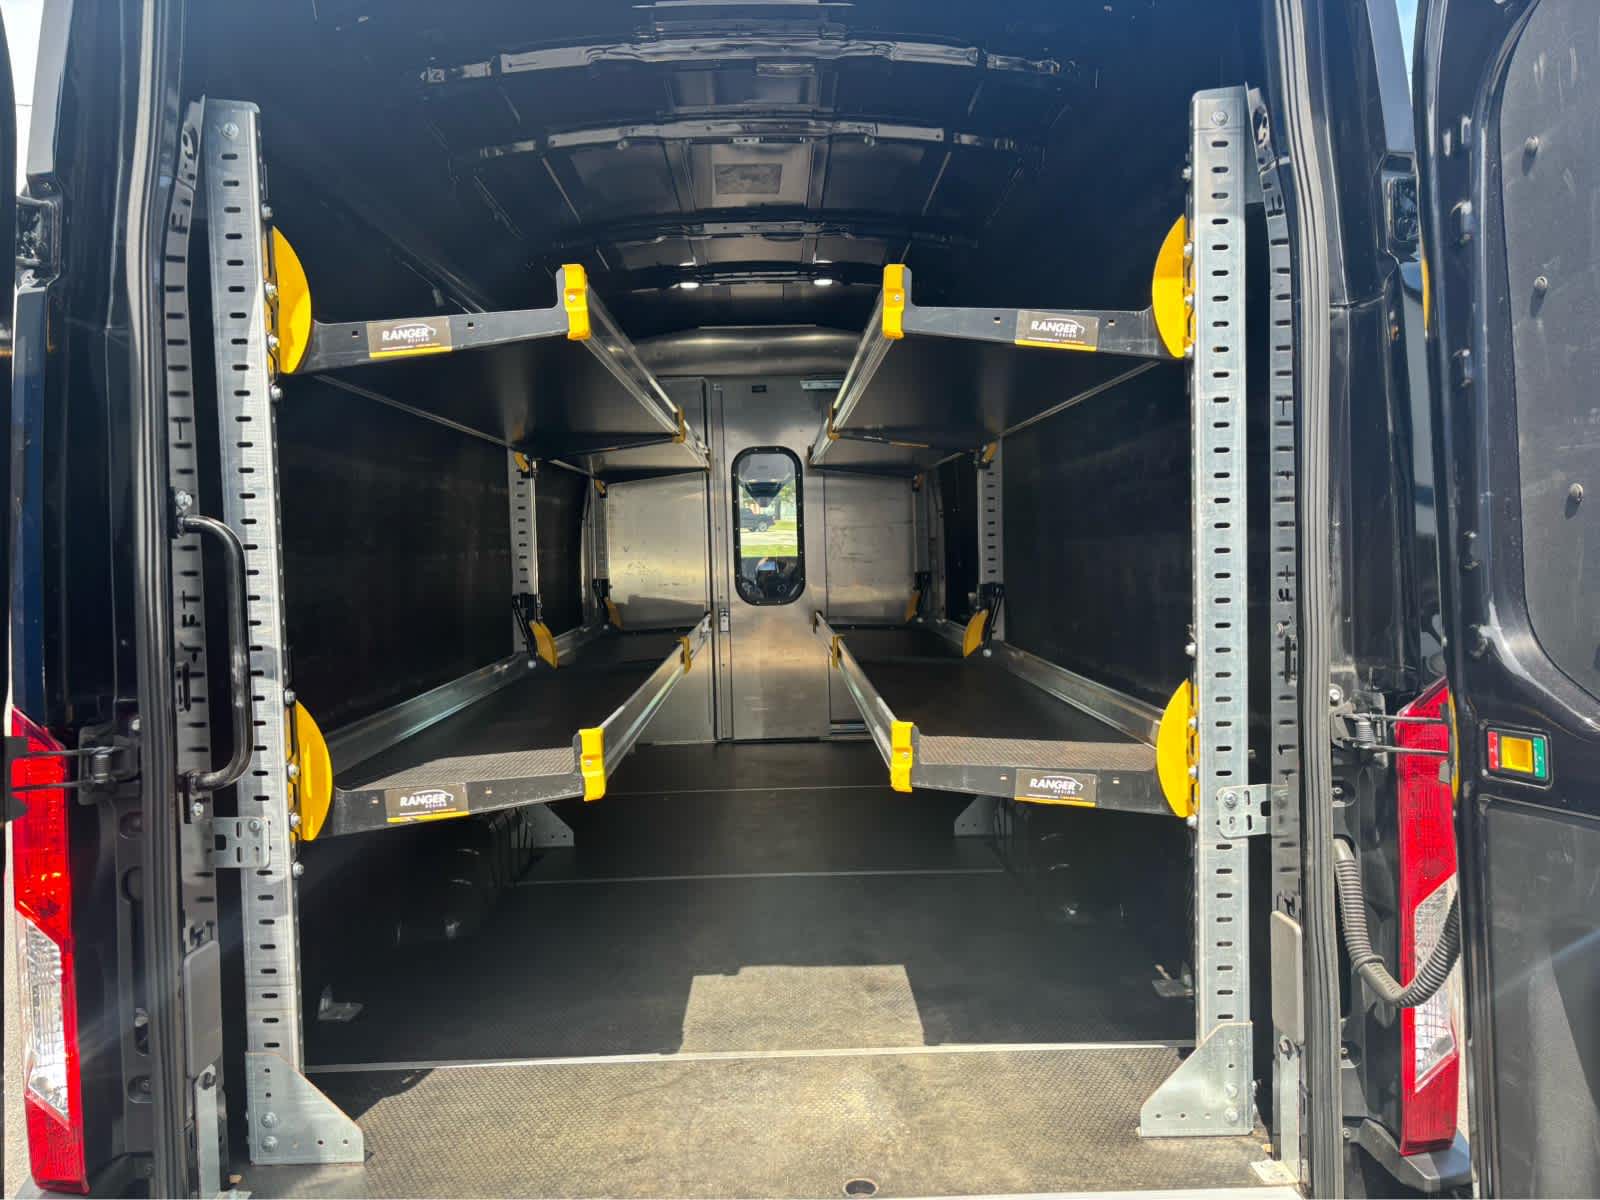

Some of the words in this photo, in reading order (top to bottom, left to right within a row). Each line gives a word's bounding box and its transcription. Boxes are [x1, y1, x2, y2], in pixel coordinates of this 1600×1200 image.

[1031, 320, 1077, 334] RANGER
[382, 327, 429, 342] RANGER
[1029, 778, 1076, 791] RANGER
[400, 793, 447, 807] RANGER
